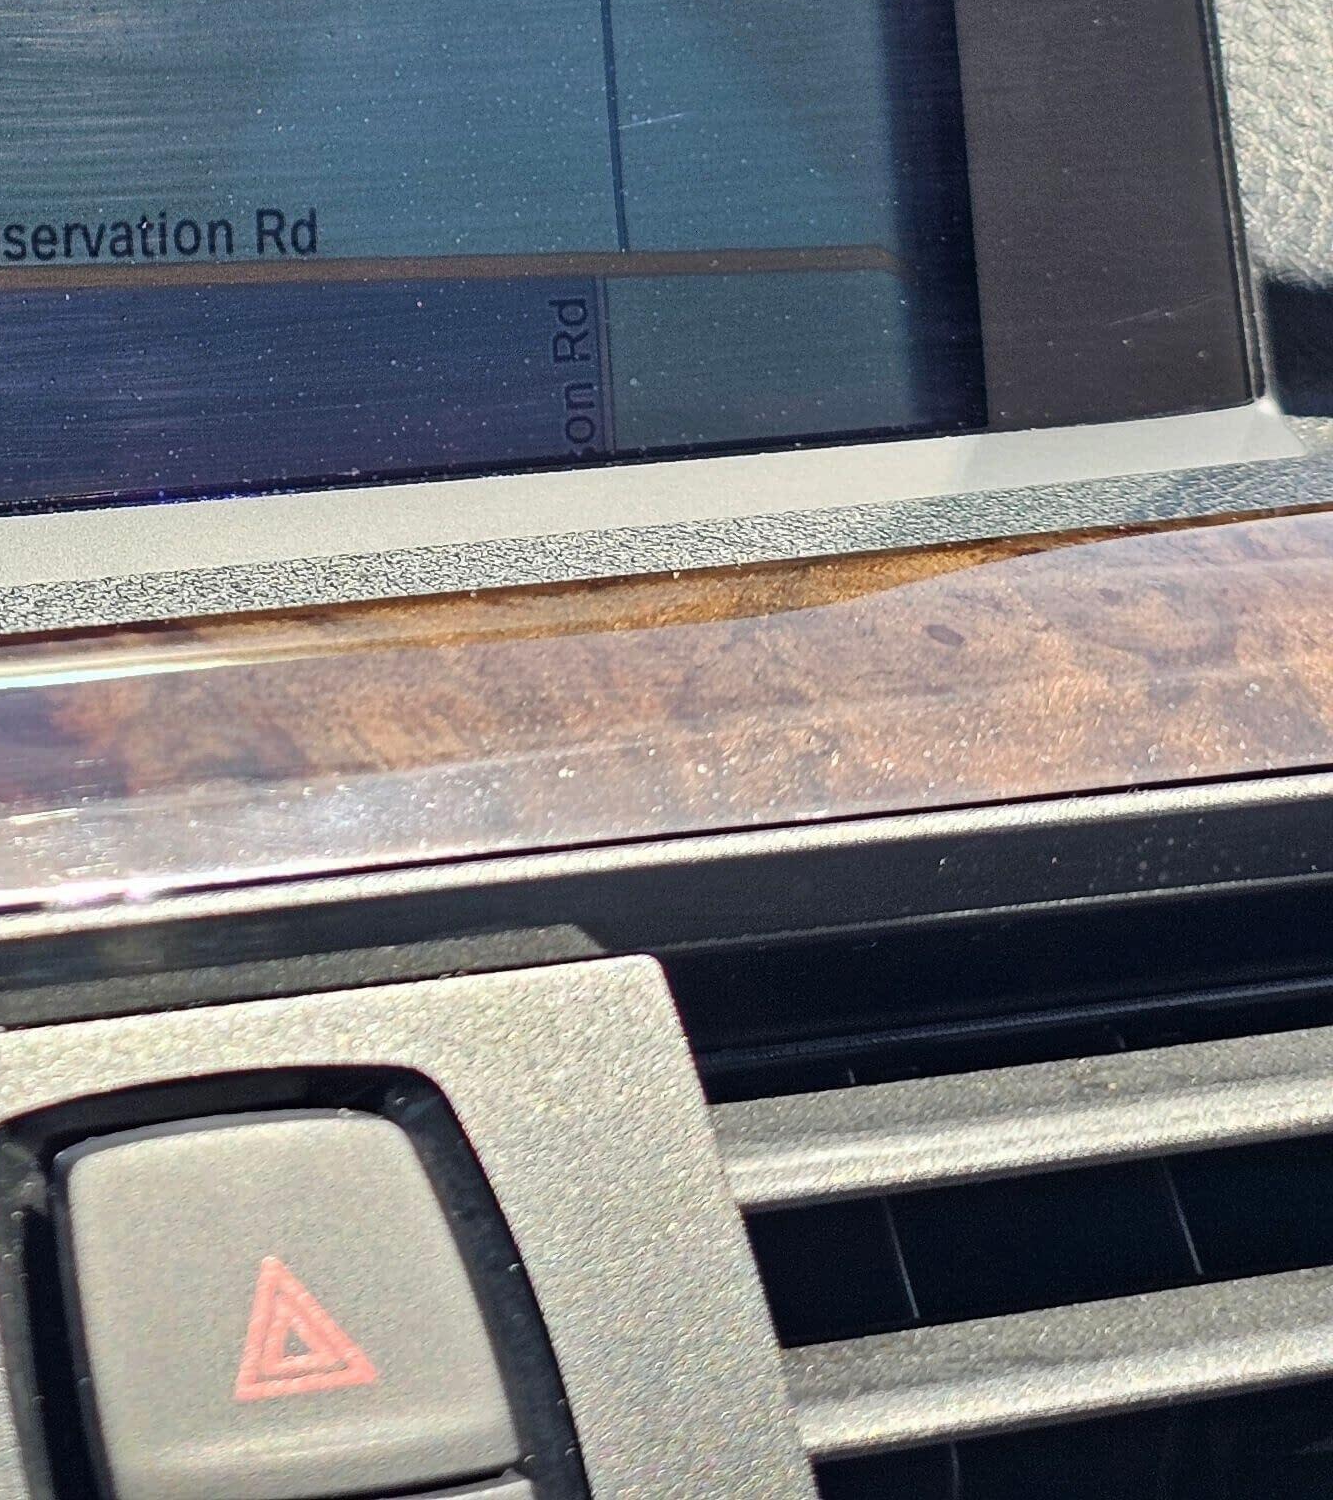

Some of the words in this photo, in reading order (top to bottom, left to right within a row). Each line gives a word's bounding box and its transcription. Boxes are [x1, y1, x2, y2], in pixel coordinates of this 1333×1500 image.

[255, 208, 318, 254] Rd
[549, 299, 591, 363] Rd
[565, 382, 595, 452] on
